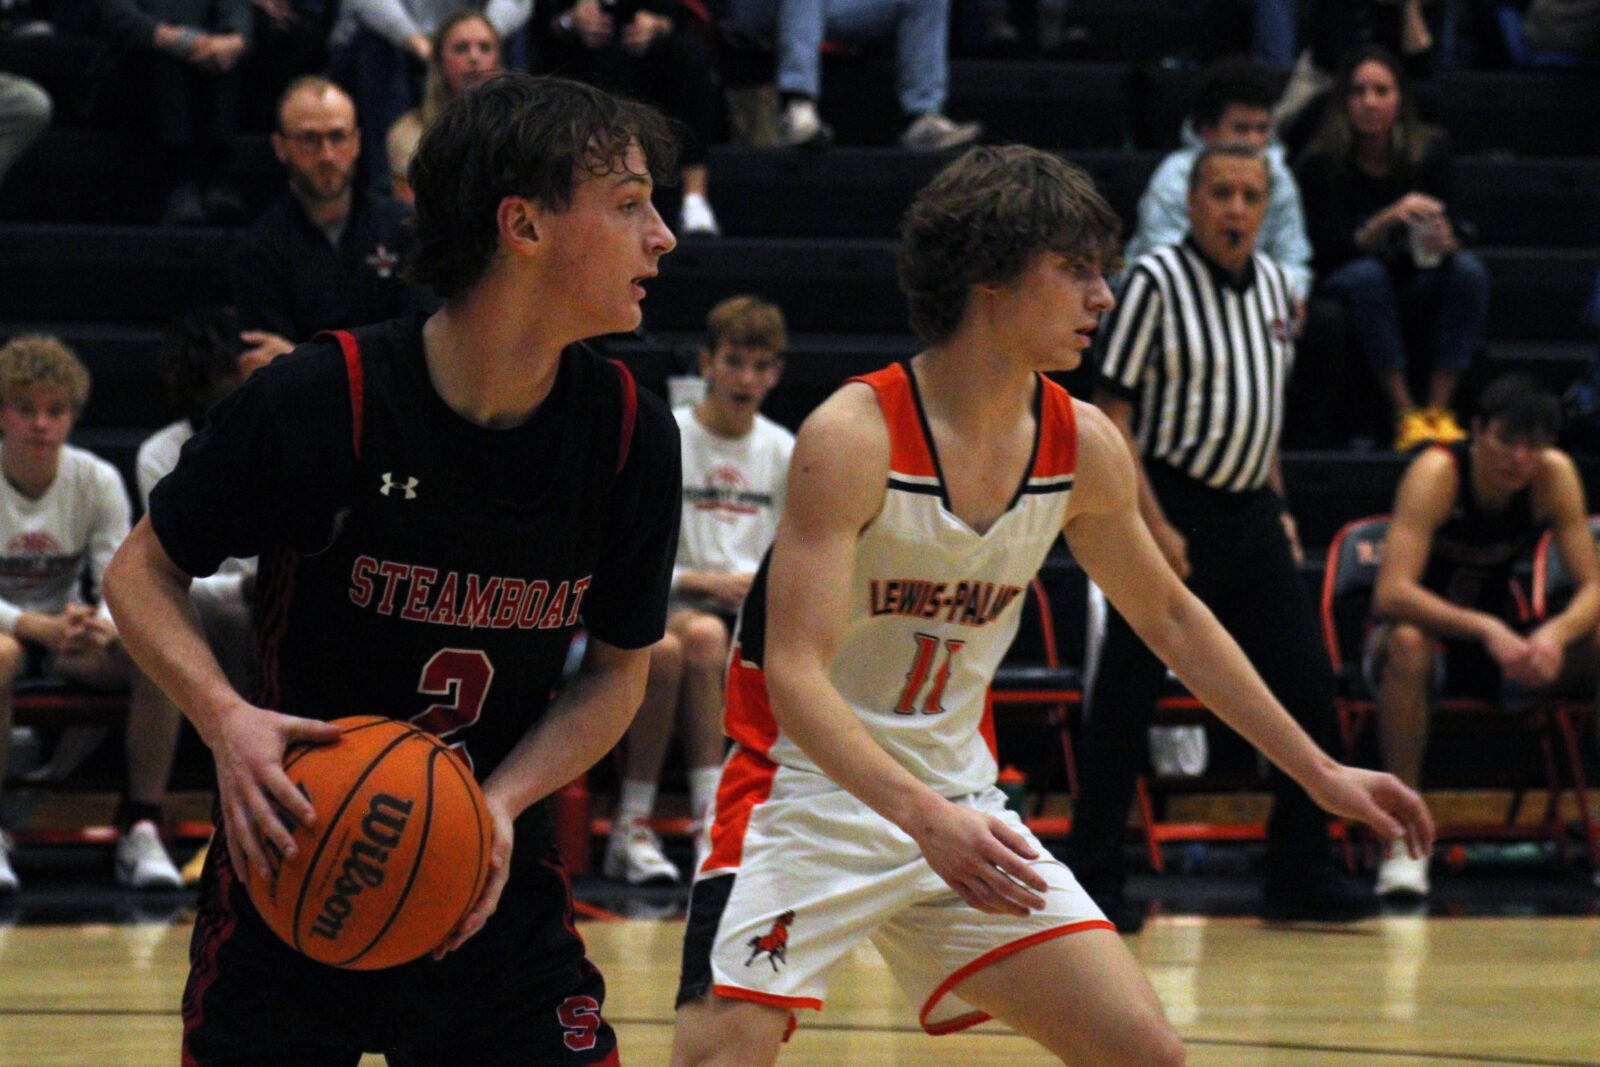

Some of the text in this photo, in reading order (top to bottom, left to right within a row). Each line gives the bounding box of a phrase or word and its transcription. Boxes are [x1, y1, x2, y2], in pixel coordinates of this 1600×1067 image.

[349, 554, 593, 630] STEAMBOAT
[409, 647, 494, 774] 2
[893, 632, 966, 716] 11
[309, 792, 416, 941] Wilson
[556, 994, 600, 1052] S
